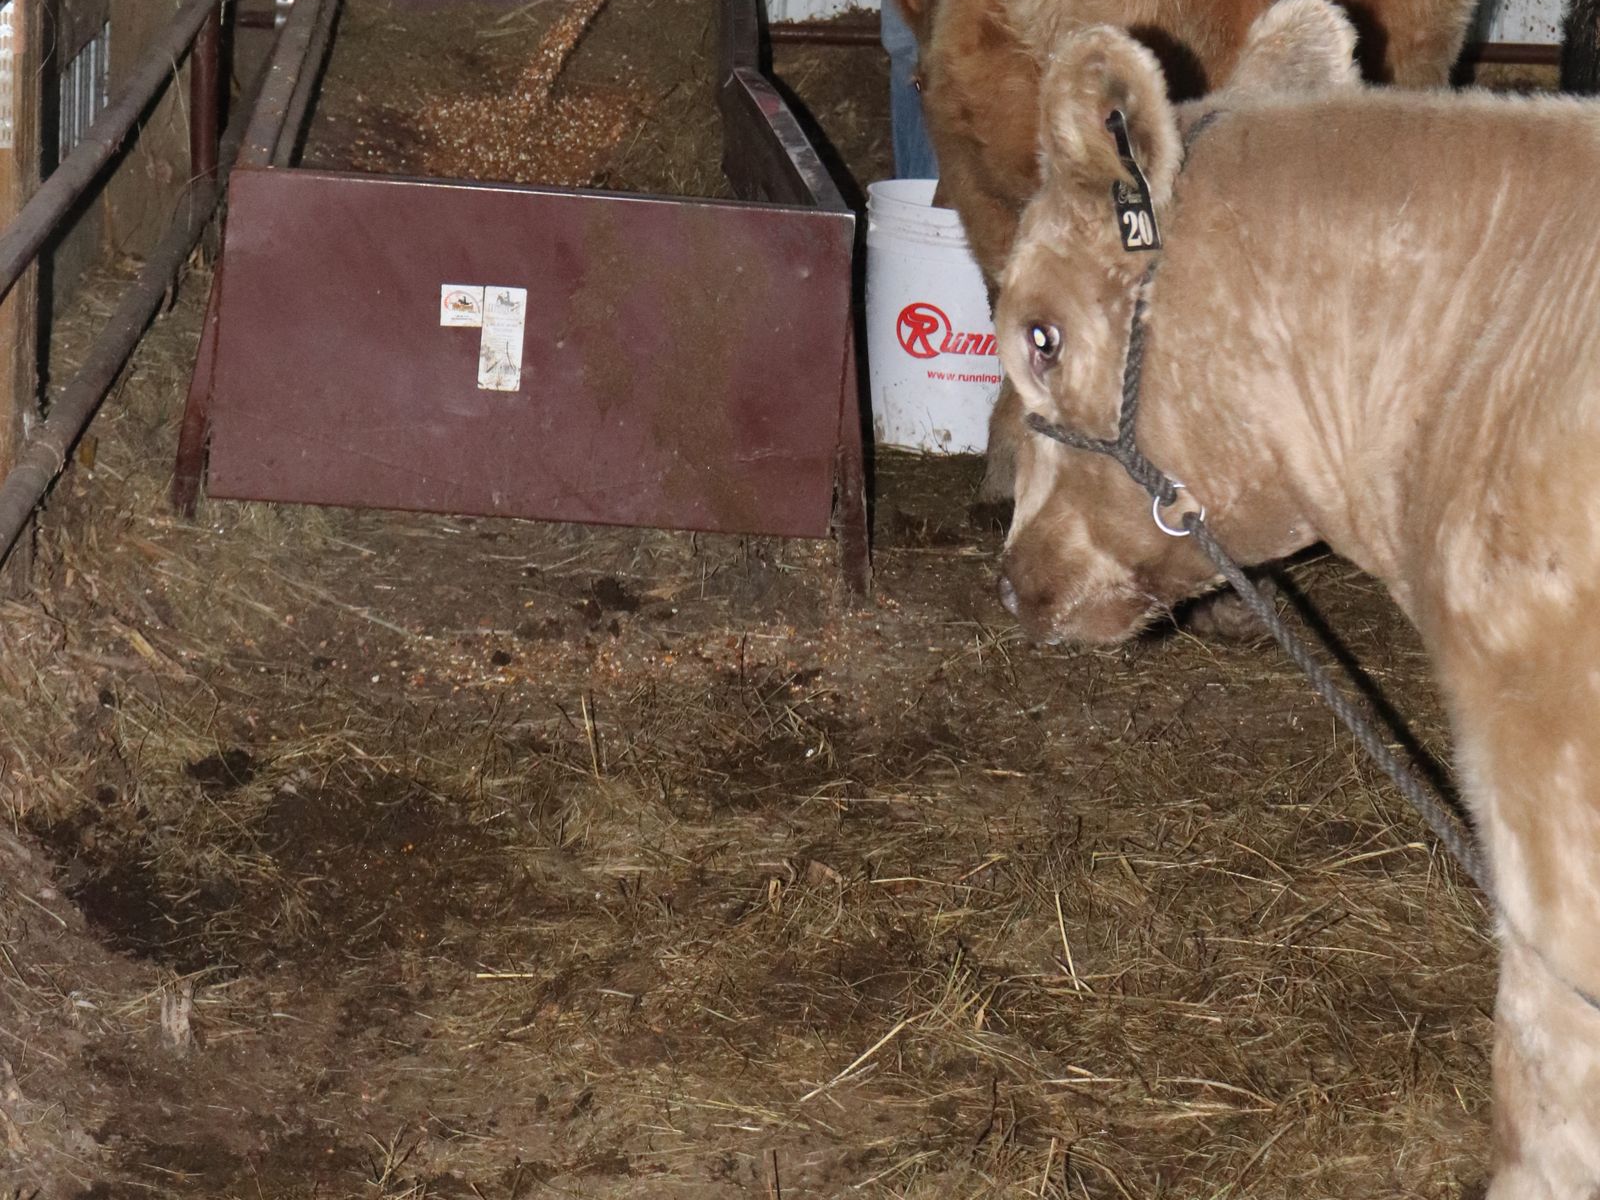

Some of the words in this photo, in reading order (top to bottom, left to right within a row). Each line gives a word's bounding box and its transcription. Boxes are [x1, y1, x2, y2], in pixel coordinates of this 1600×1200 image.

[1123, 210, 1153, 247] 20
[896, 302, 999, 359] Runn
[927, 370, 1002, 384] www.runnings
